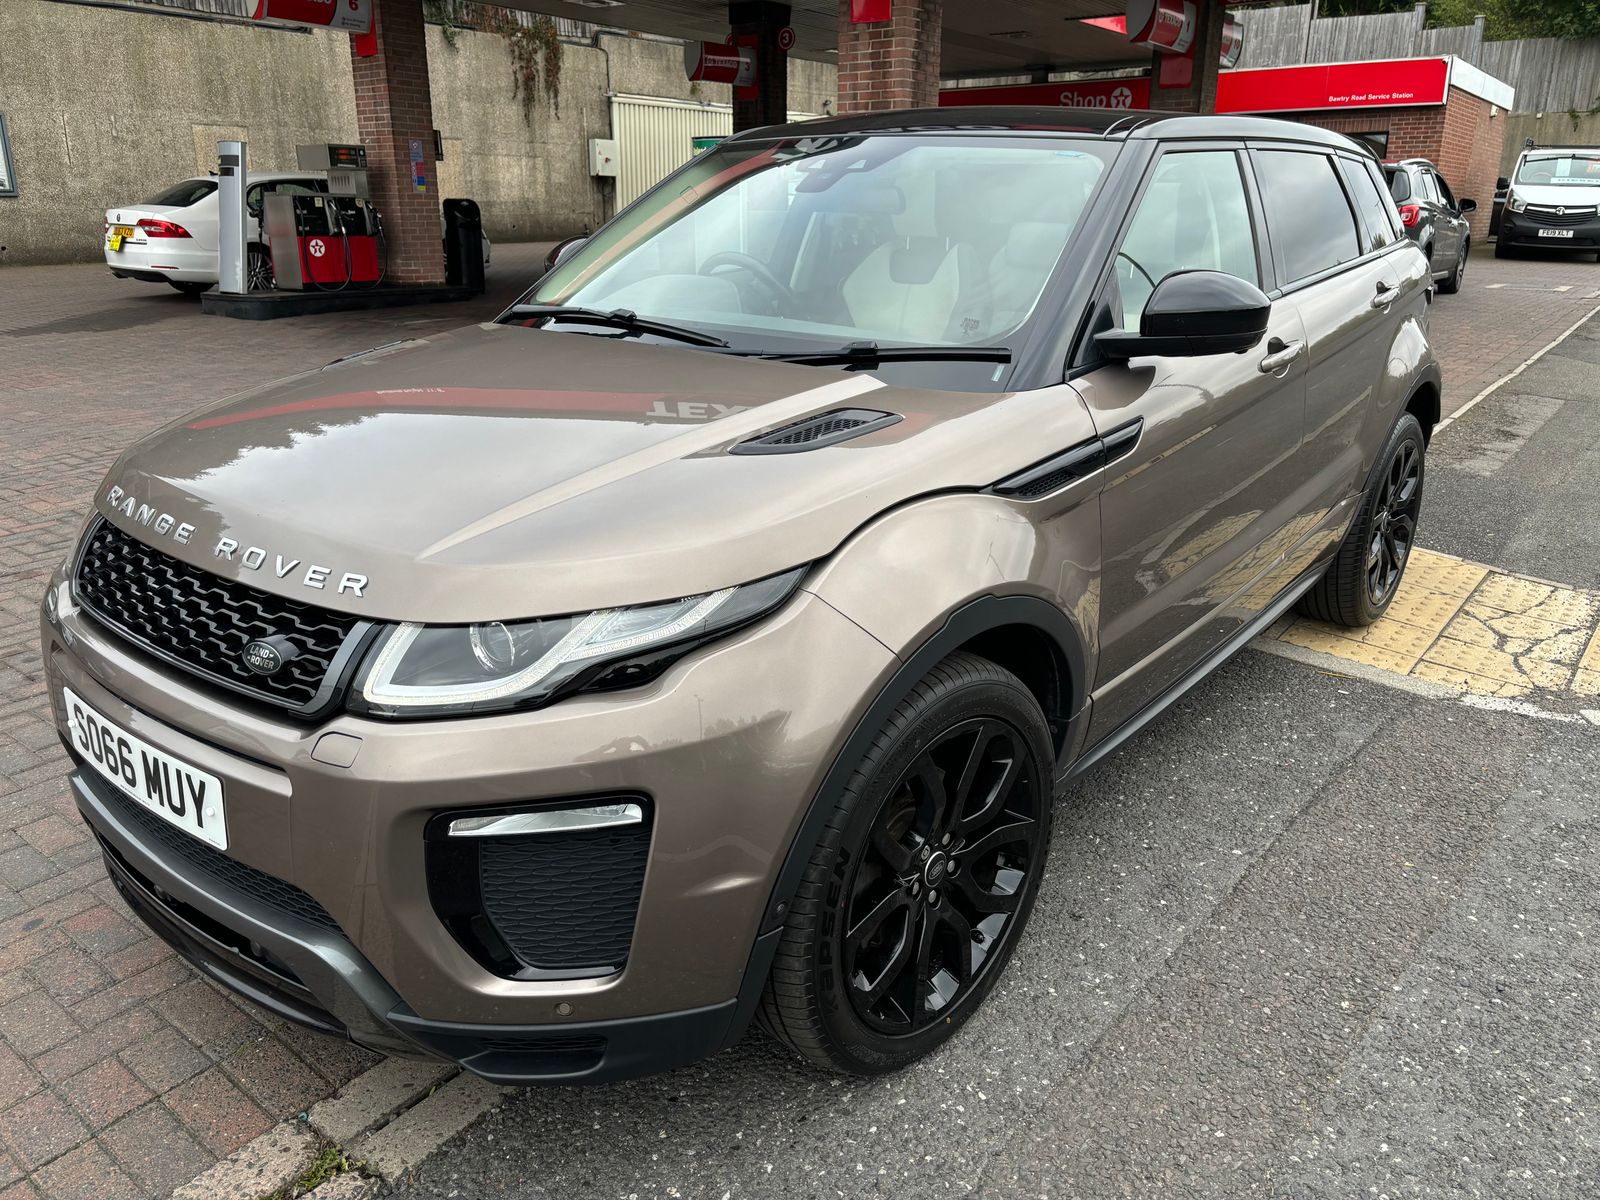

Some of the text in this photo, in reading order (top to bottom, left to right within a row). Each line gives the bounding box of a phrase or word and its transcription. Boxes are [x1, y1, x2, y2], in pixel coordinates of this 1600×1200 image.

[782, 32, 790, 44] 3
[1060, 91, 1107, 107] Shop
[1328, 95, 1349, 103] Bawtry
[106, 485, 369, 598] RANGE ROVER
[250, 644, 270, 658] LAND
[250, 655, 275, 670] ROVER
[73, 703, 206, 829] SO66 MUY
